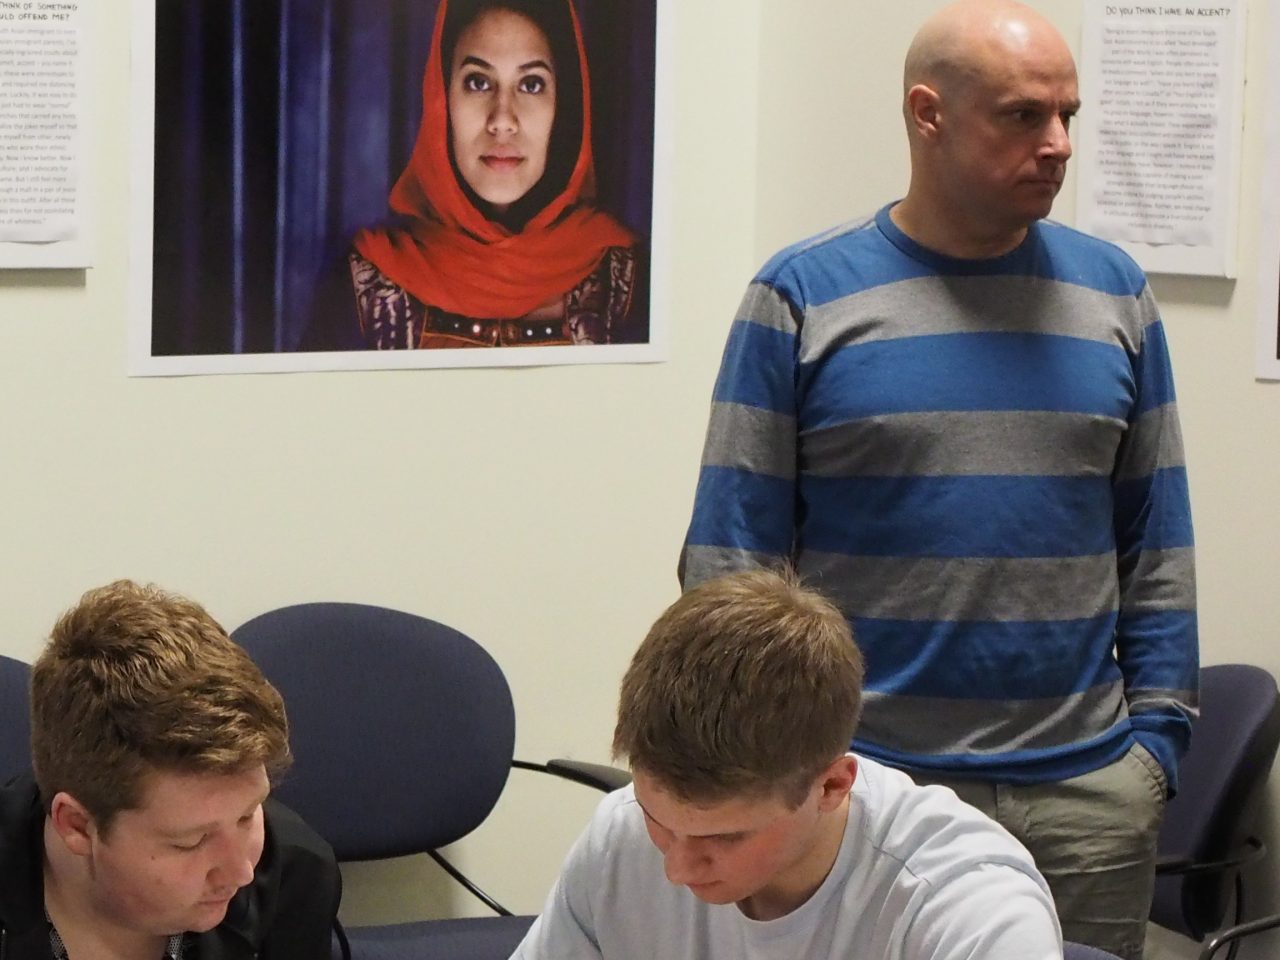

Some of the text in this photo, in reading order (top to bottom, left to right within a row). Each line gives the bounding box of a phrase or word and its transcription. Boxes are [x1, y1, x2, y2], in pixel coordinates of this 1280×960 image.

[39, 3, 78, 11] SOMETHING
[1105, 6, 1117, 15] DO
[1135, 6, 1157, 15] THINK
[1185, 8, 1195, 16] AN
[18, 12, 48, 20] OFFEND
